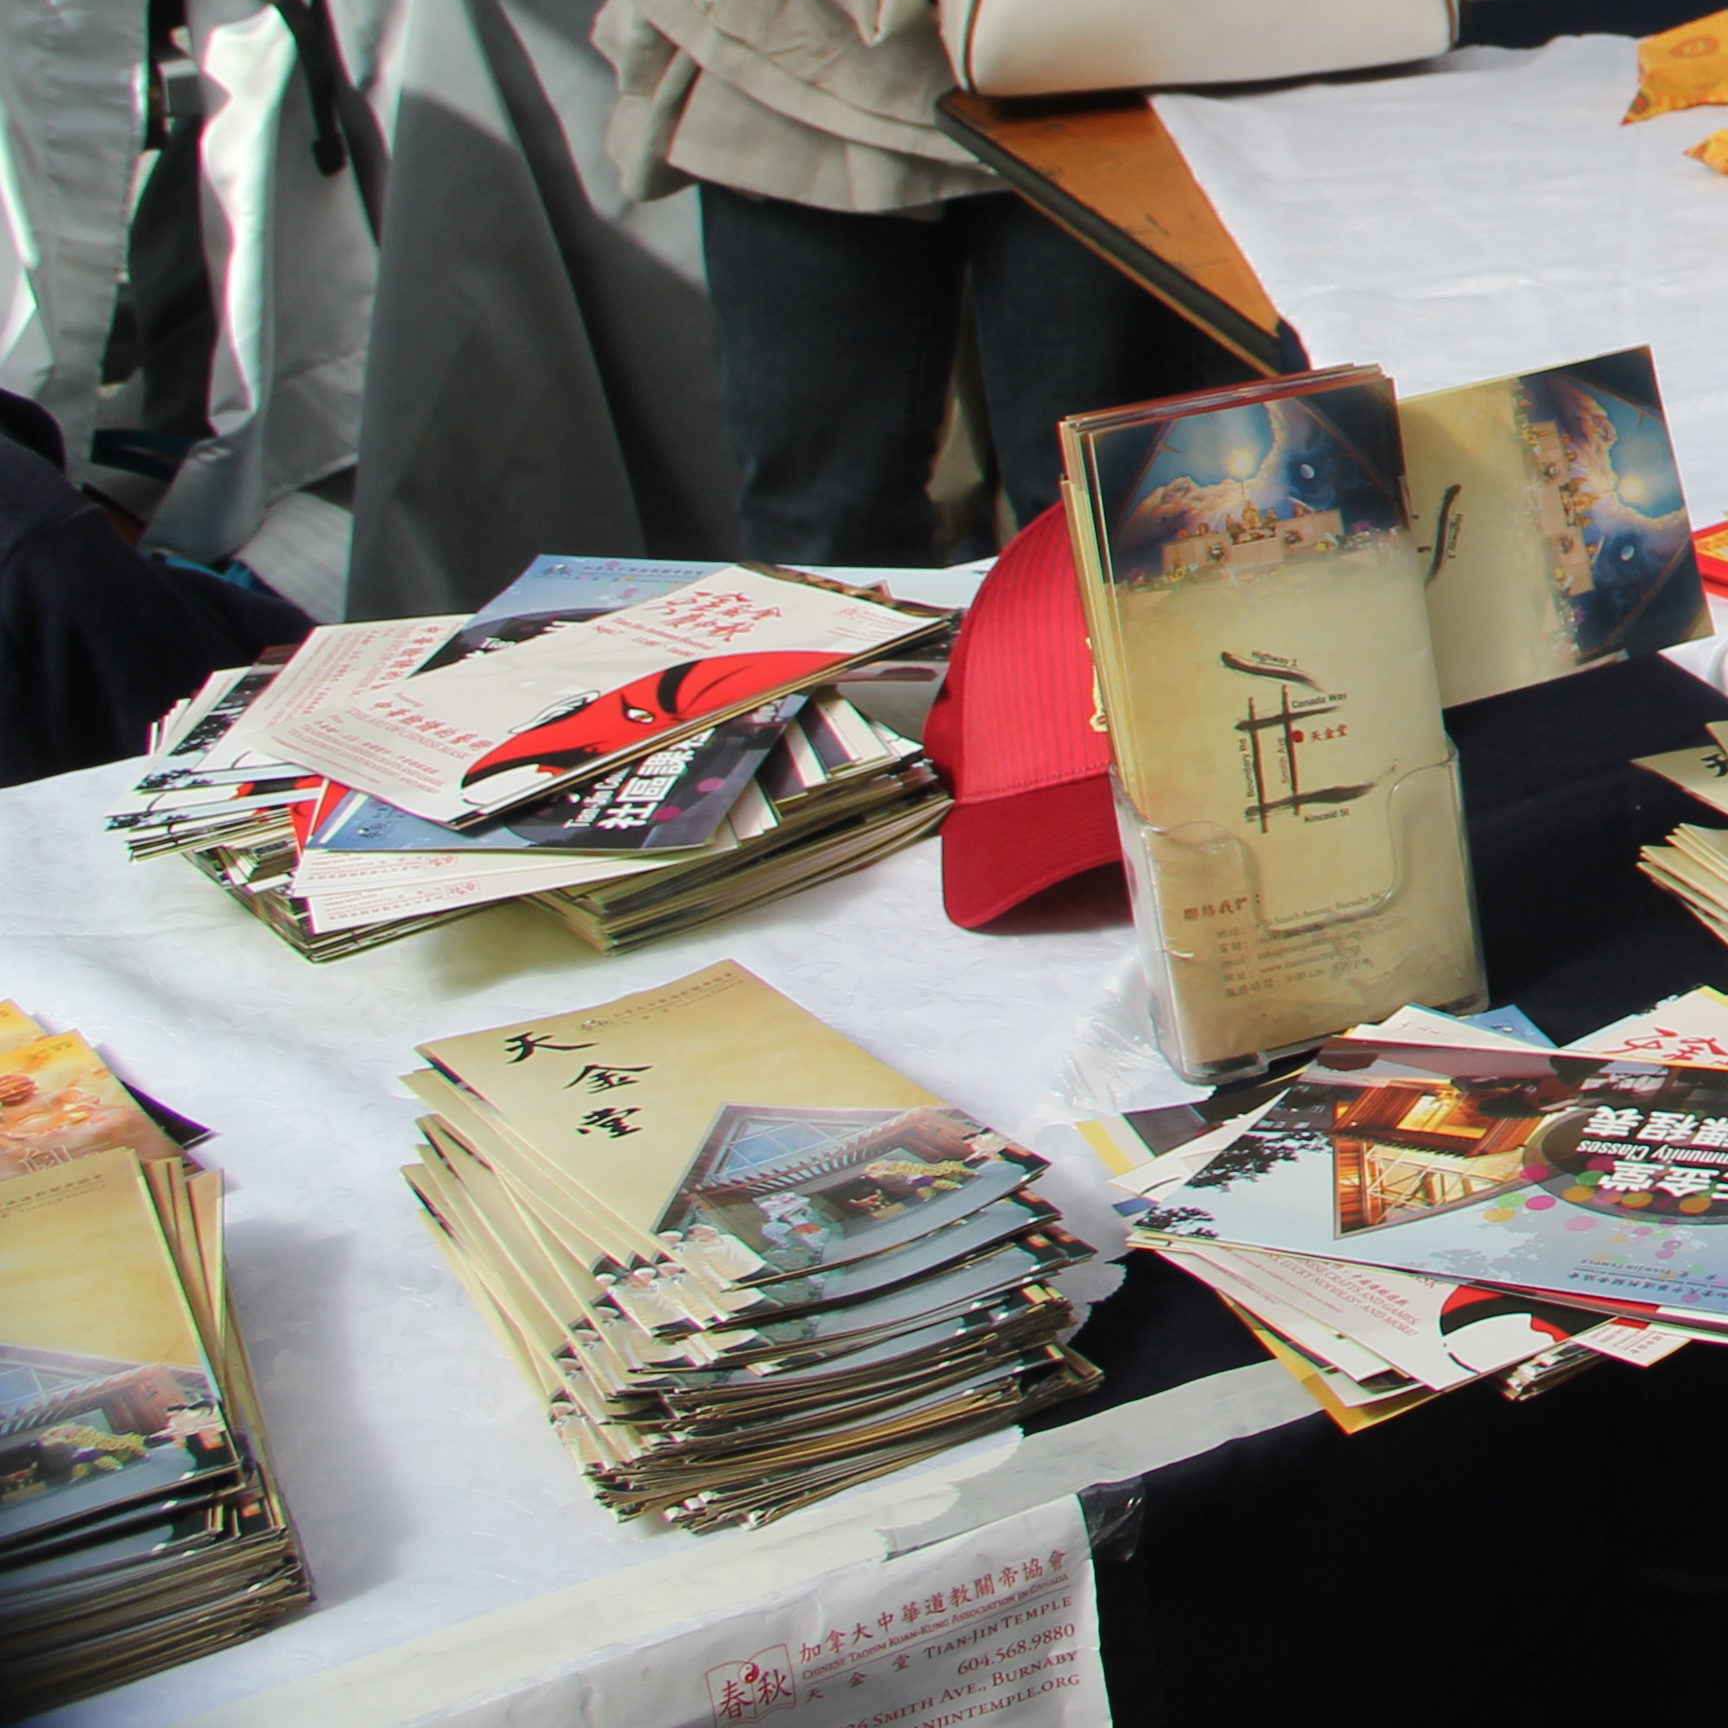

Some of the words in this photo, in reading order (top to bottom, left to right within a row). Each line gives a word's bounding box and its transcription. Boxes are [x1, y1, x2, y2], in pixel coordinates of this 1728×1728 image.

[1252, 649, 1290, 666] Highway
[1292, 695, 1326, 709] Canada
[1329, 692, 1348, 703] Way
[1311, 724, 1348, 743] 天金堂
[503, 1031, 655, 1140] 天金堂
[1576, 1139, 1651, 1161] Classes
[799, 1549, 1067, 1664] 加拿大中華道教關帝協會
[803, 1656, 847, 1680] CHINESE
[888, 1619, 950, 1650] KUAN-KUNG
[951, 1596, 1017, 1628] ASSOCIATION
[1030, 1573, 1069, 1596] CANADA
[923, 1622, 998, 1660] TIAN-JIN
[1003, 1595, 1073, 1630] TEMPLE
[957, 1622, 1076, 1676] 604.568.9880
[717, 1669, 793, 1720] 春秋
[873, 1695, 937, 1724] SMITH
[991, 1650, 1078, 1688] BURNABY
